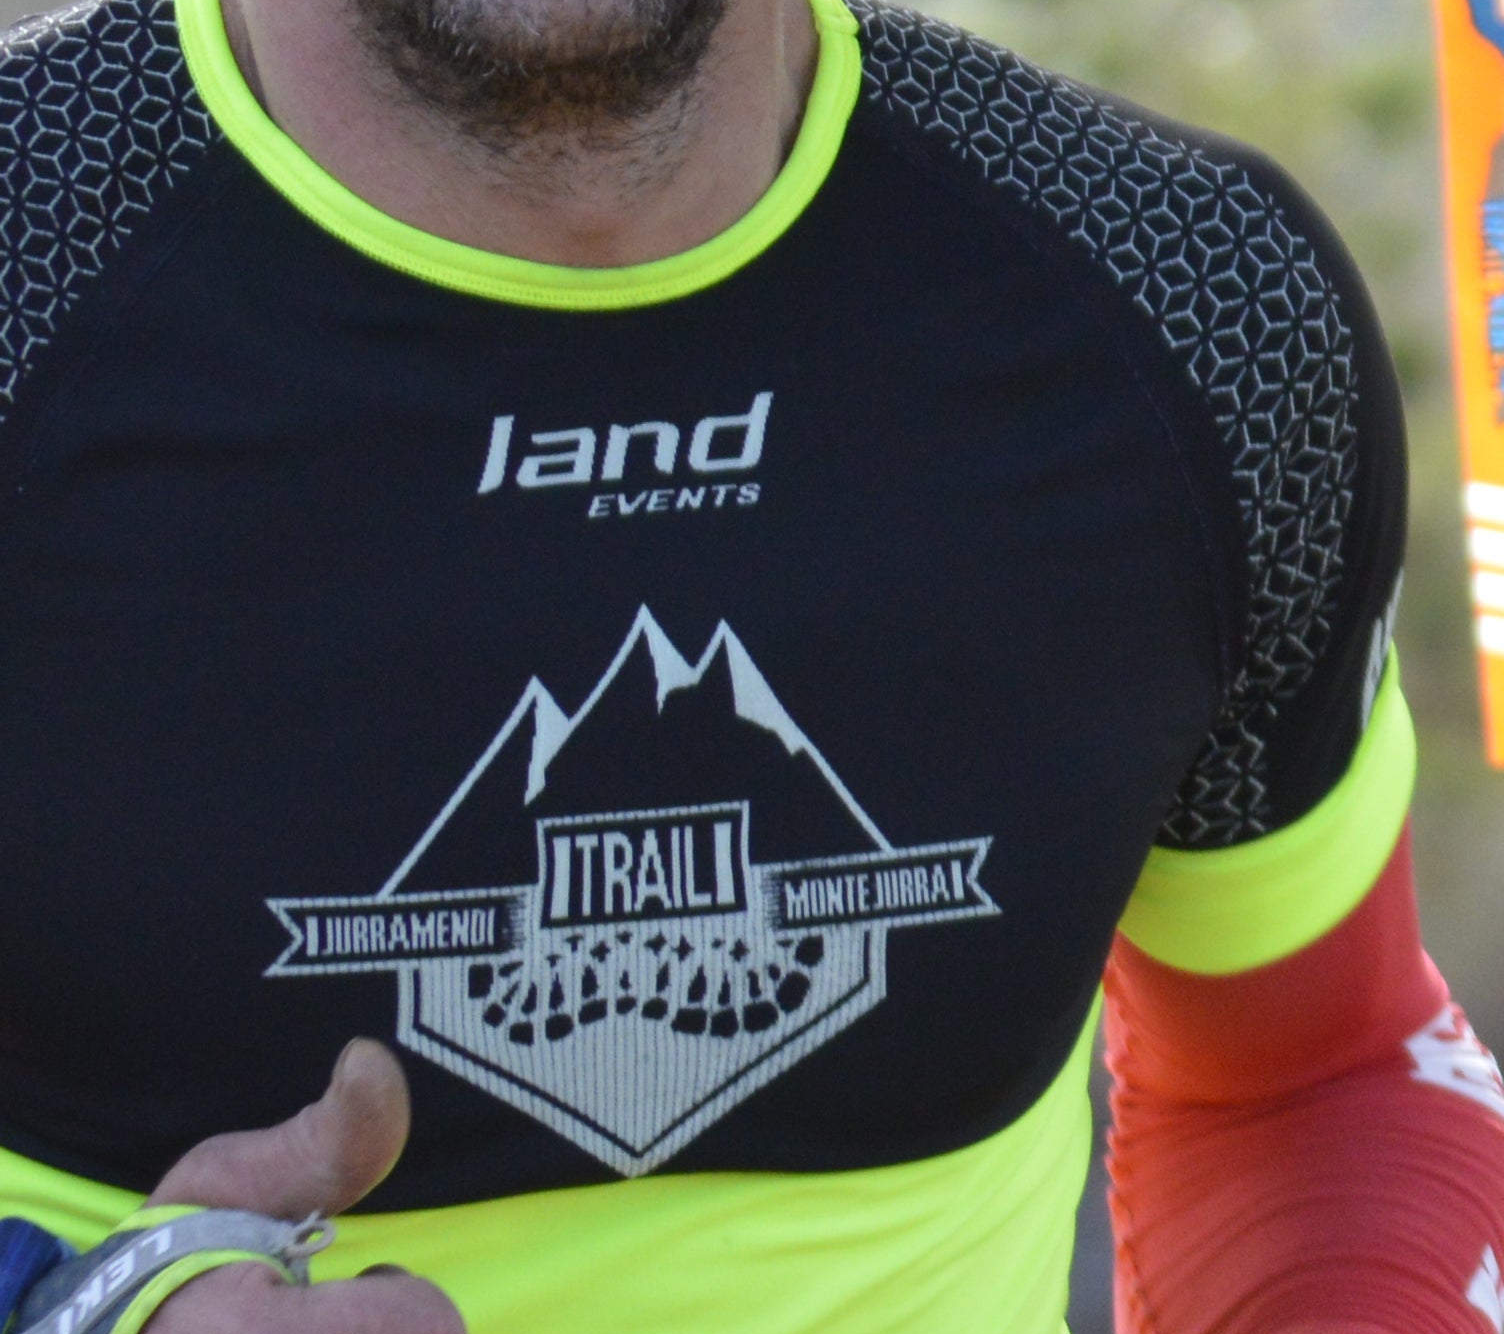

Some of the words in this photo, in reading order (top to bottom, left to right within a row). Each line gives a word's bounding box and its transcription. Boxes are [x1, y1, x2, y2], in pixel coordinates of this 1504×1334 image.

[477, 391, 774, 495] land
[588, 482, 762, 519] EVENTS
[575, 825, 712, 917] TRAIL
[321, 907, 496, 954] JURRAMENDI
